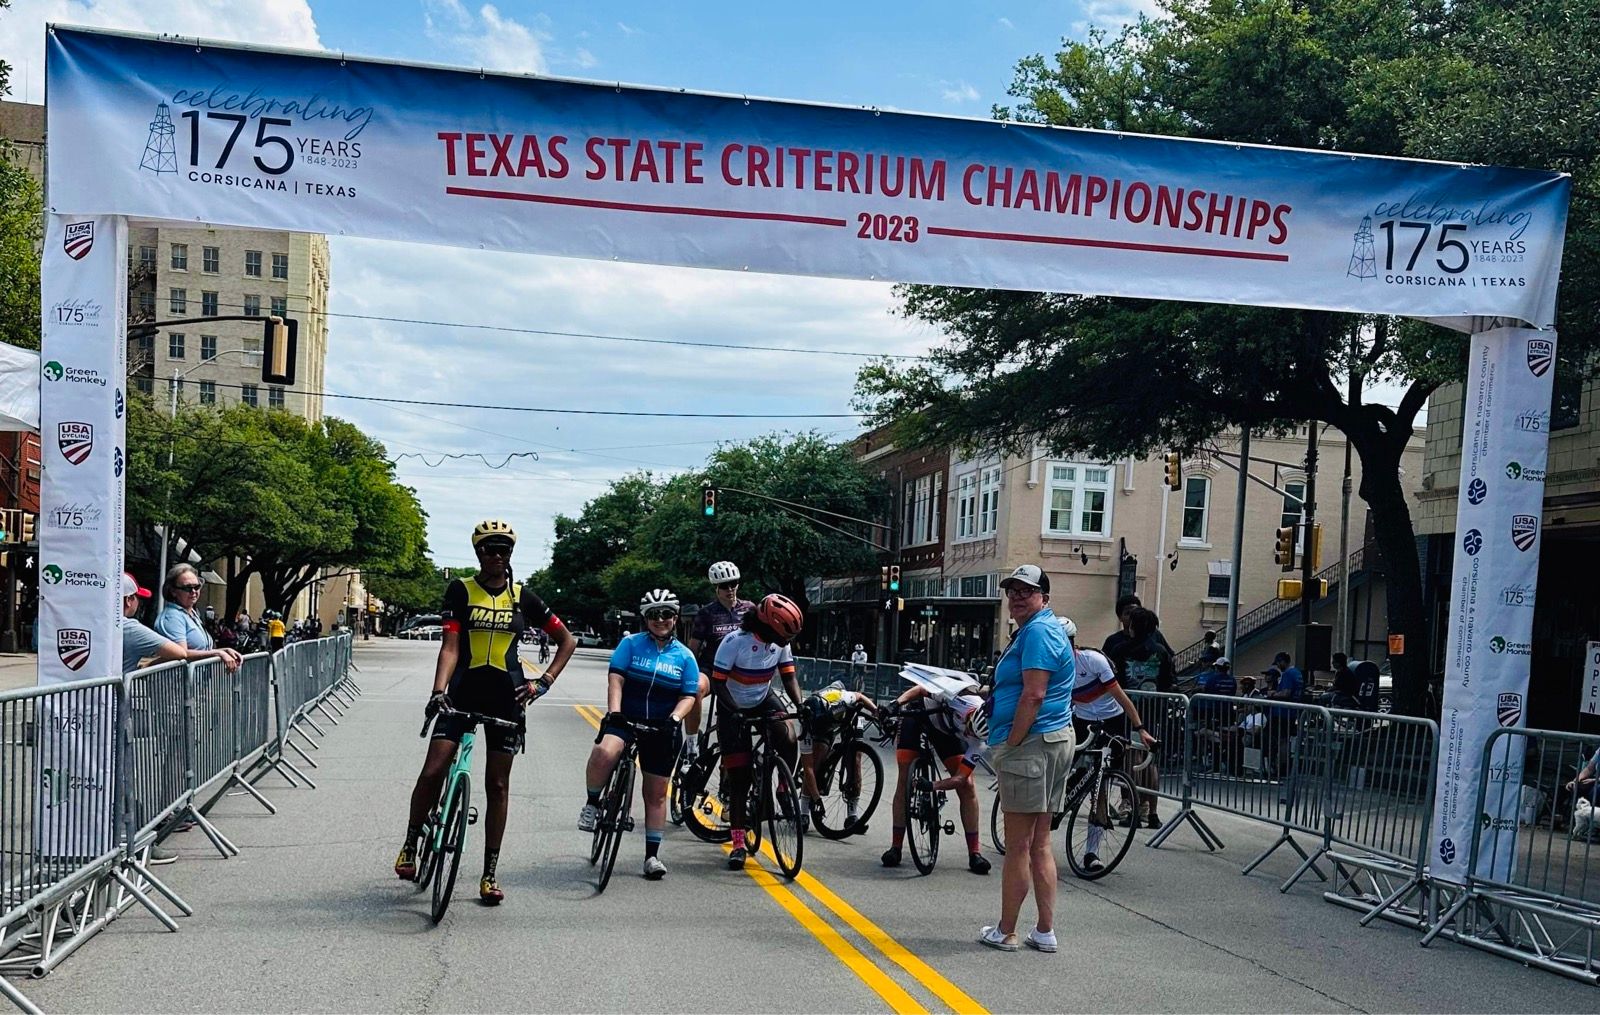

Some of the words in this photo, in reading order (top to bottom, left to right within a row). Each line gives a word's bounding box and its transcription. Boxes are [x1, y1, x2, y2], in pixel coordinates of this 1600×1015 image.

[182, 110, 295, 175] 175
[297, 137, 361, 159] YEARS
[301, 155, 358, 169] 1848-2023
[188, 171, 287, 192] CORSICANA
[305, 183, 356, 198] TEXAS
[438, 132, 569, 179] TEXAS
[585, 137, 704, 184] STATE
[721, 143, 946, 201] CRITERIUM
[962, 163, 1292, 245] CHAMPIONSHIPS
[69, 223, 91, 234] USA
[857, 212, 919, 243] 2023
[1380, 220, 1469, 274] 175
[1470, 240, 1526, 254] YEARS
[1385, 274, 1466, 287] CORSICANA
[1481, 277, 1526, 287] TEXAS
[57, 307, 84, 323] 175
[1530, 341, 1550, 351] USA
[65, 367, 98, 376] Green
[65, 375, 107, 387] Monkey
[1471, 429, 1480, 477] corsicana
[1477, 381, 1485, 418] navarro
[1481, 345, 1490, 378] county
[1482, 420, 1490, 456] chamber
[1487, 363, 1495, 407] commerce
[61, 424, 90, 435] USA
[1520, 416, 1540, 430] 175
[1522, 467, 1546, 476] Green
[1522, 474, 1546, 482] Monke
[56, 511, 84, 527] 175
[1514, 517, 1535, 526] USA
[65, 570, 98, 579] Green
[1470, 557, 1480, 604] corsicana
[65, 579, 106, 589] Monkey
[1505, 591, 1524, 604] 175
[469, 607, 513, 624] MACC
[60, 631, 88, 641] USA
[1466, 616, 1475, 653] navarro
[1456, 626, 1464, 668] commerce
[1506, 641, 1531, 649] Green
[1506, 648, 1532, 656] Monke
[1462, 655, 1471, 688] county
[1500, 695, 1520, 704] USA
[1449, 708, 1459, 739] county
[1446, 742, 1454, 778] navarro
[1451, 782, 1459, 819] chamber
[1455, 727, 1464, 770] commerce
[1441, 790, 1450, 835] corsicana
